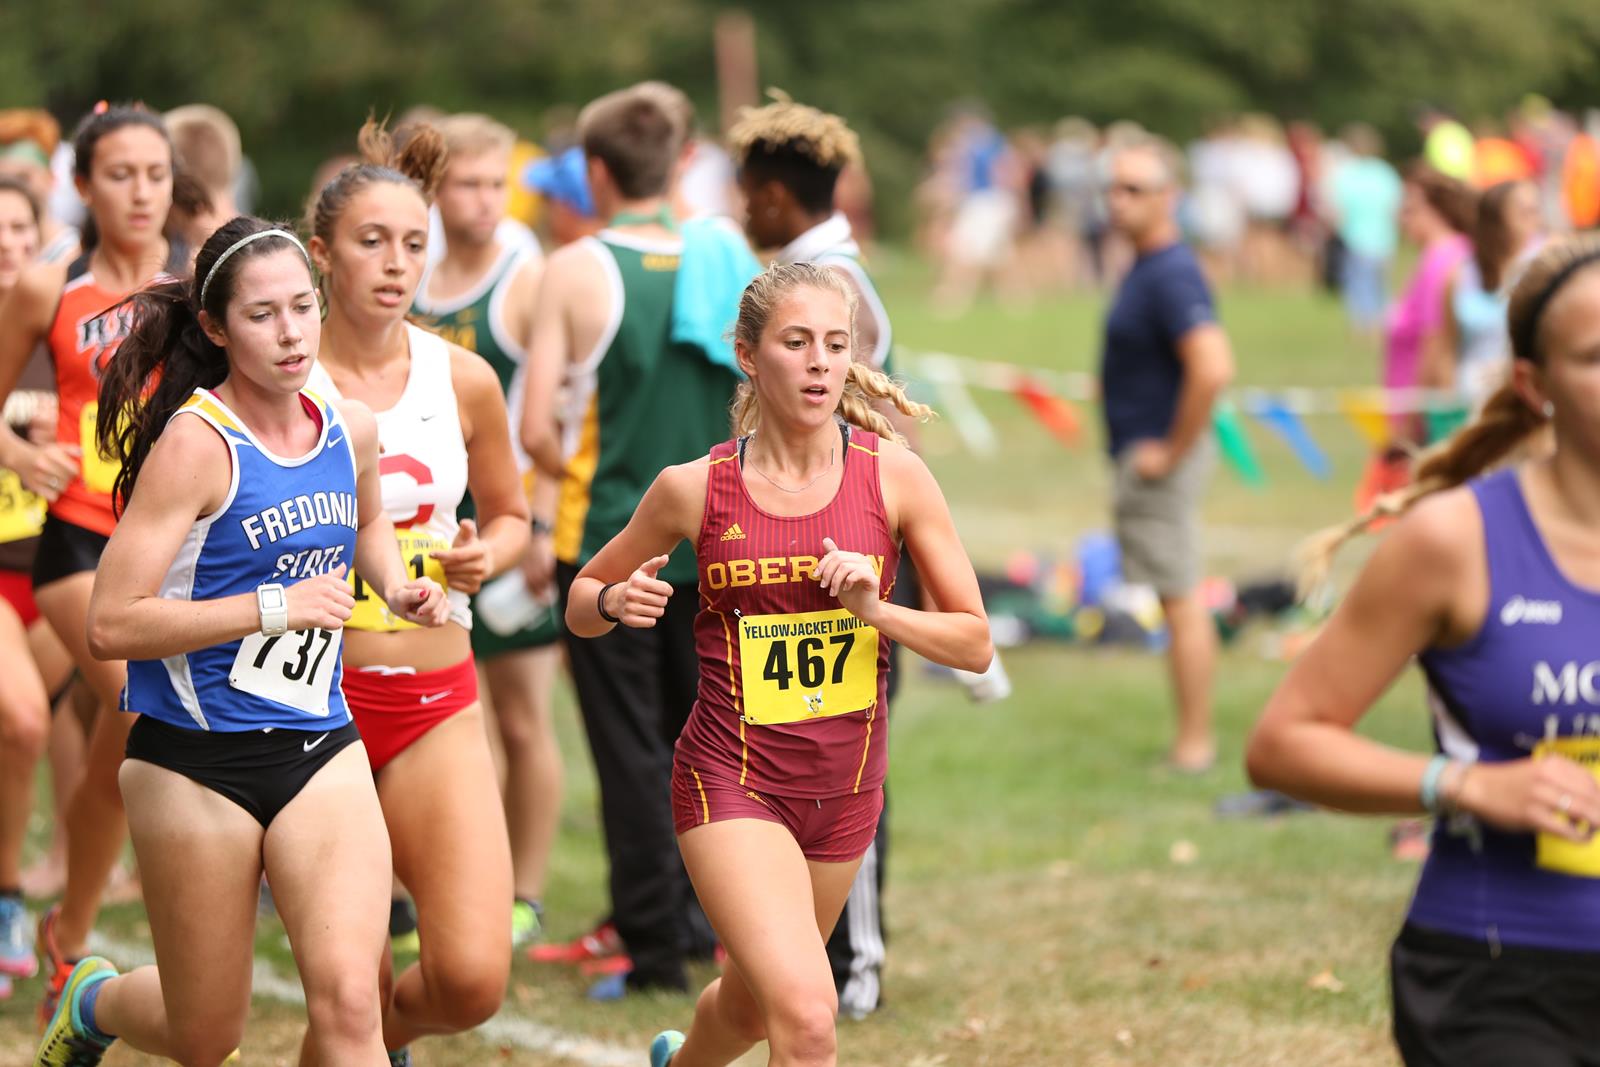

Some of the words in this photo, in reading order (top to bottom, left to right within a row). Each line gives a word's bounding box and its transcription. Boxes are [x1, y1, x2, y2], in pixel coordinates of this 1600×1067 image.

[272, 544, 345, 579] STATE
[706, 554, 885, 590] OBERN
[744, 620, 833, 639] YELLOWJACKET
[837, 616, 869, 632] INVIT
[763, 633, 855, 690] 467
